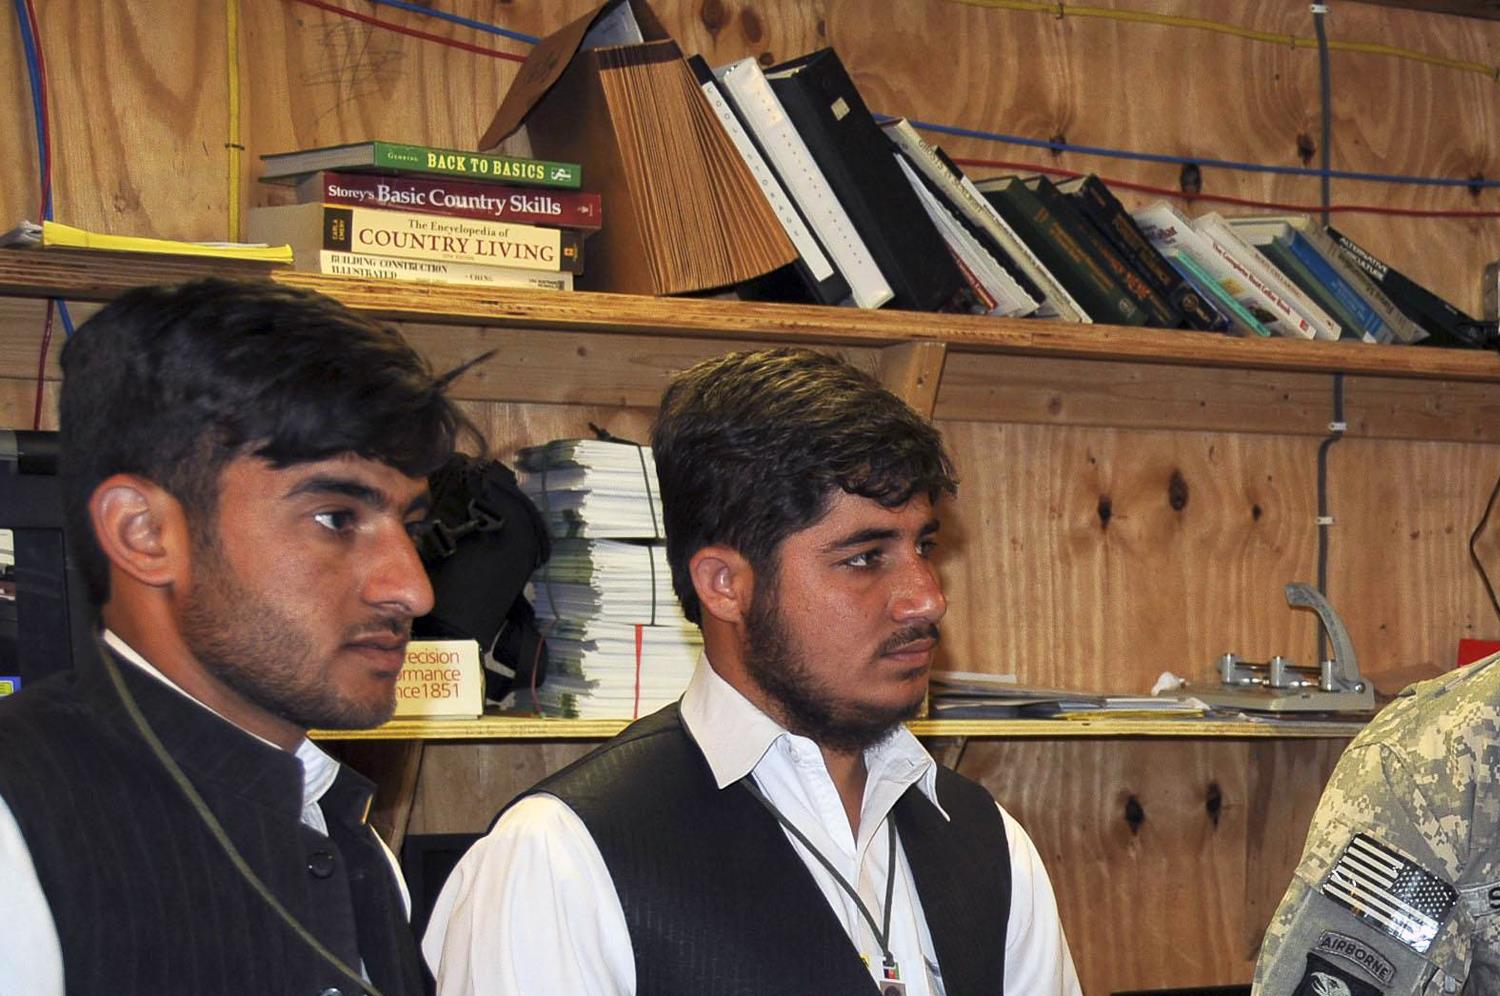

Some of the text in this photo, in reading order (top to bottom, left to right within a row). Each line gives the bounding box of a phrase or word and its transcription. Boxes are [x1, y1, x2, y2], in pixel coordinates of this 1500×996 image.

[427, 153, 466, 171] BACK
[470, 158, 489, 174] TO
[493, 160, 545, 179] BASICS
[328, 184, 562, 216] Storey's Basic Country Skills
[408, 218, 510, 239] The Encyclopedia of
[358, 228, 555, 262] COUNTRY LIVING
[331, 254, 448, 274] BUILDING CONSTRUCTION
[331, 265, 398, 279] ILLUSTRATED
[408, 648, 460, 665] ecision
[1320, 936, 1389, 980] AIRBORNE
